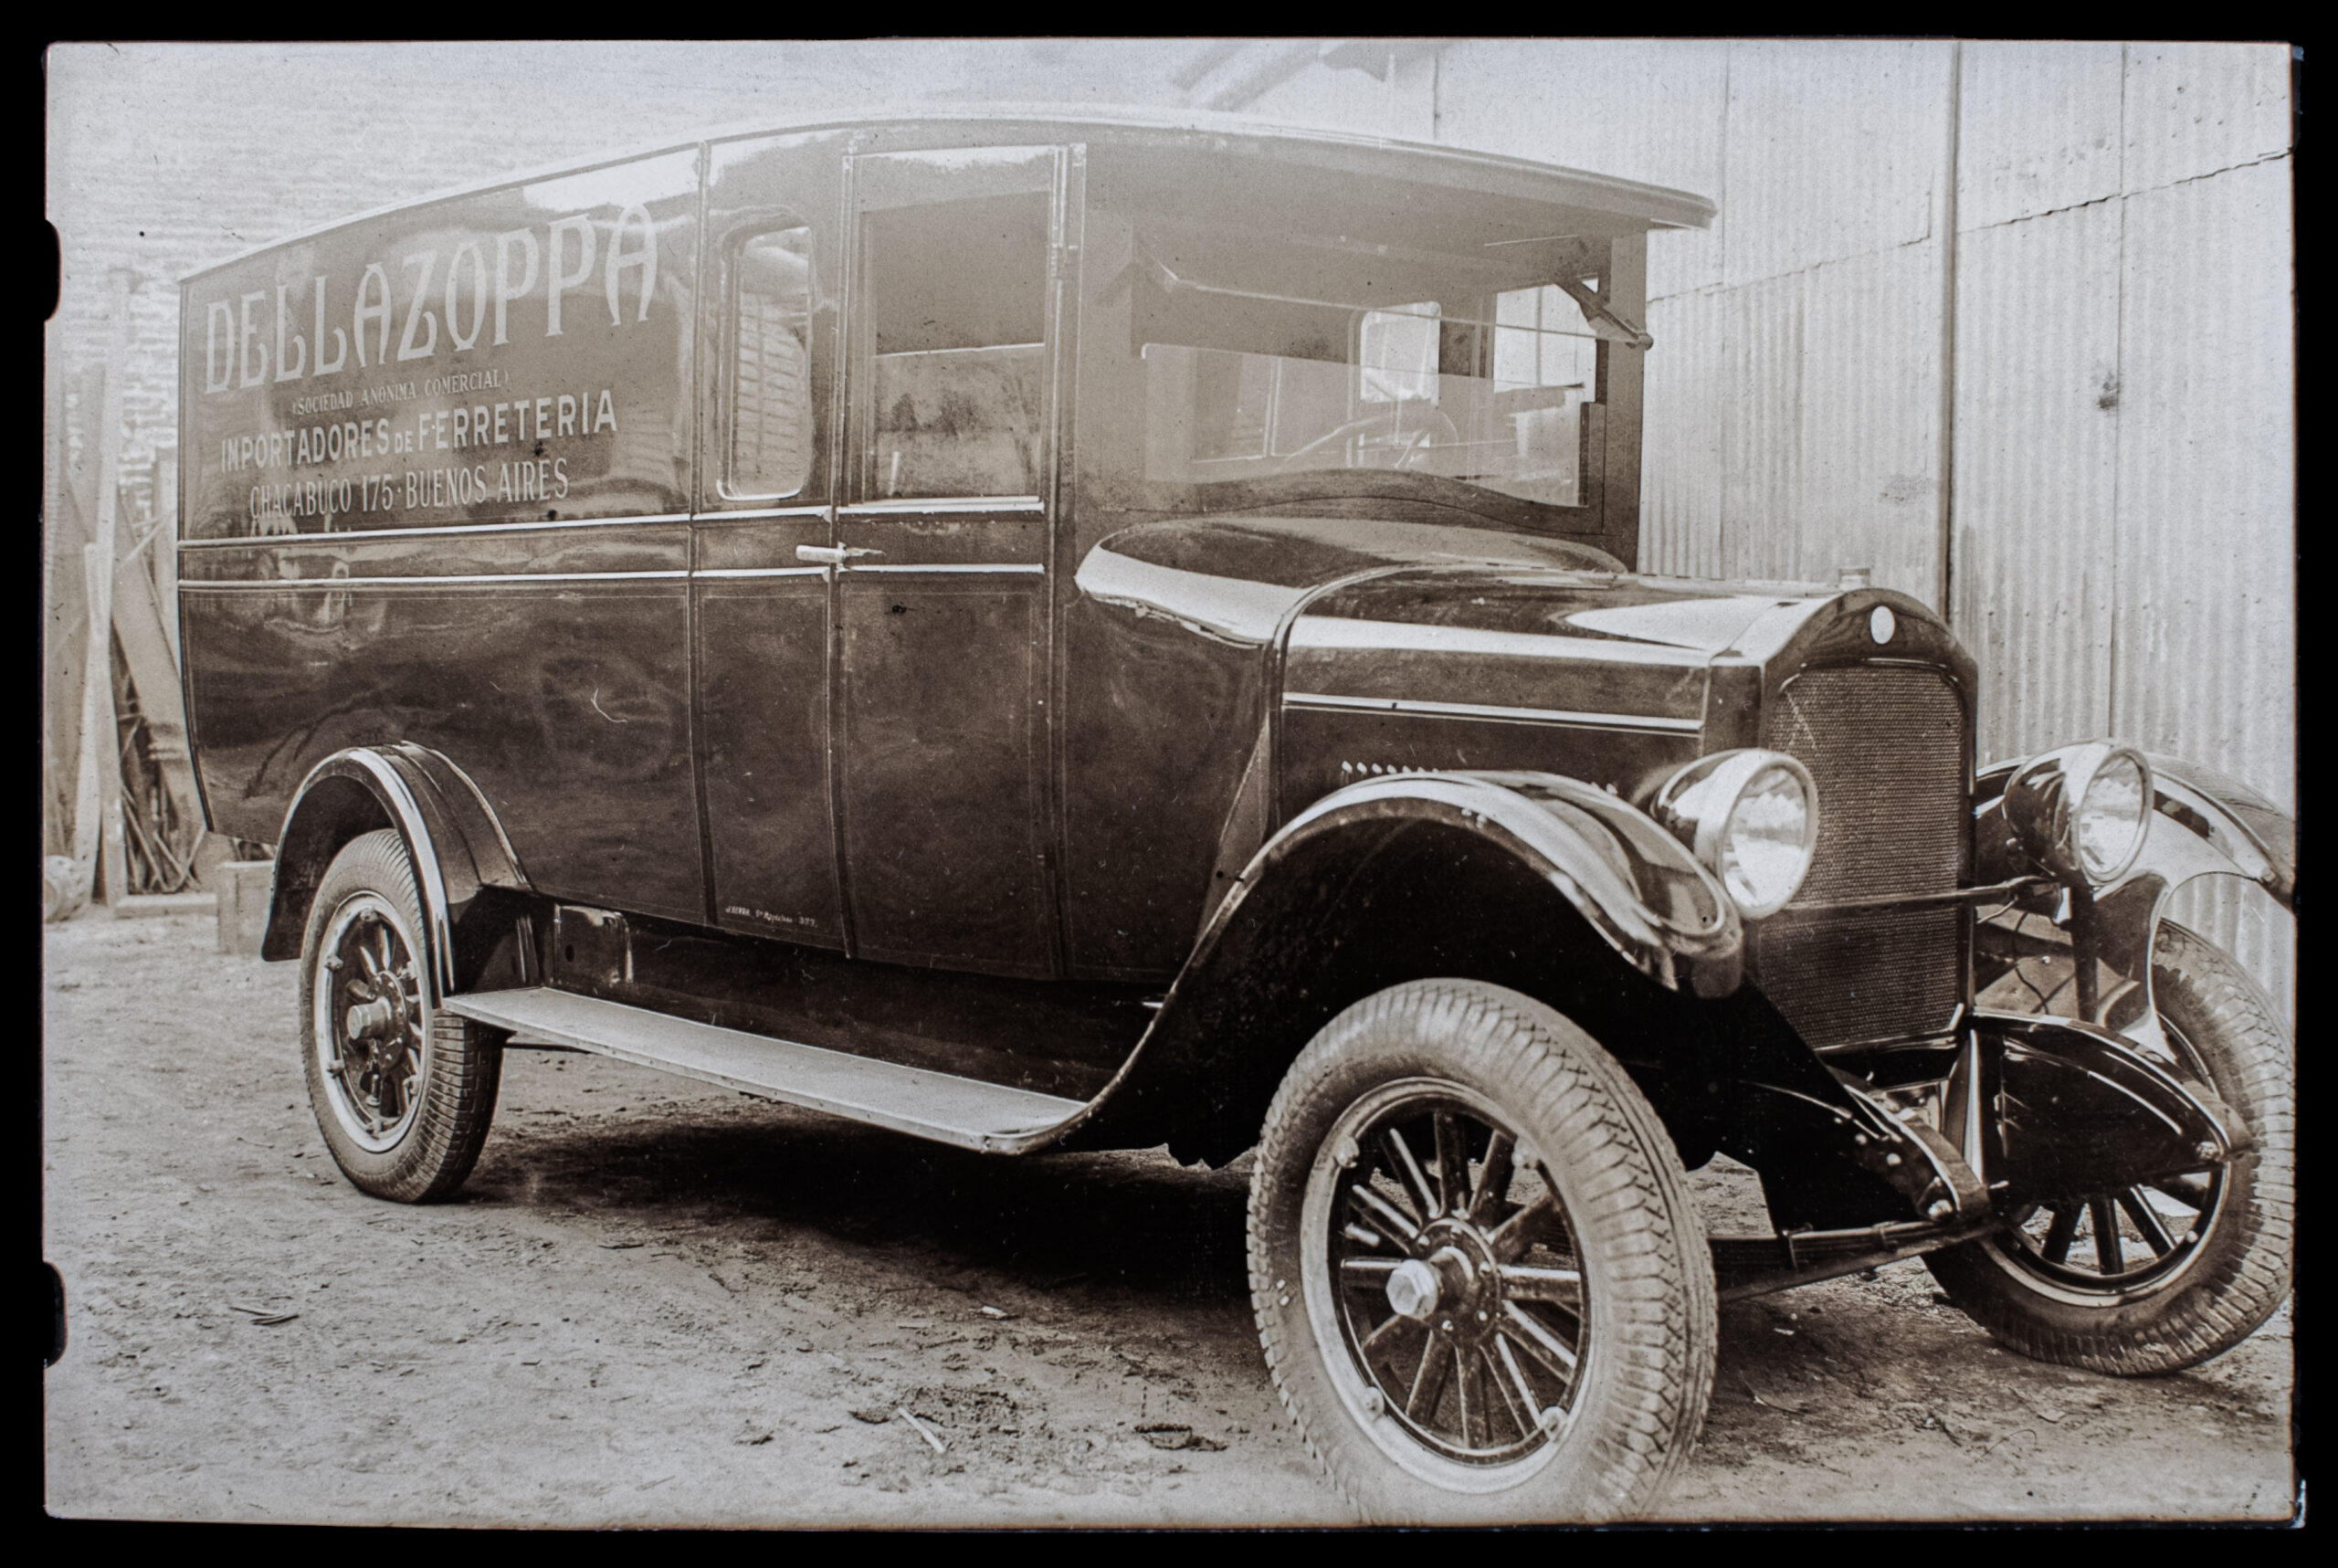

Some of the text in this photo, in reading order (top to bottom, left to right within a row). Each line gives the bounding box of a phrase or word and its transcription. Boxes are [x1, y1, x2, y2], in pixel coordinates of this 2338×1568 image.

[205, 203, 658, 395] DELLAZOPPA
[221, 389, 617, 473] IMPORTADORES DE FERRETERIA
[250, 477, 353, 520] CHACABUCO
[405, 464, 487, 510] BUENOS
[497, 457, 569, 503] AIRES
